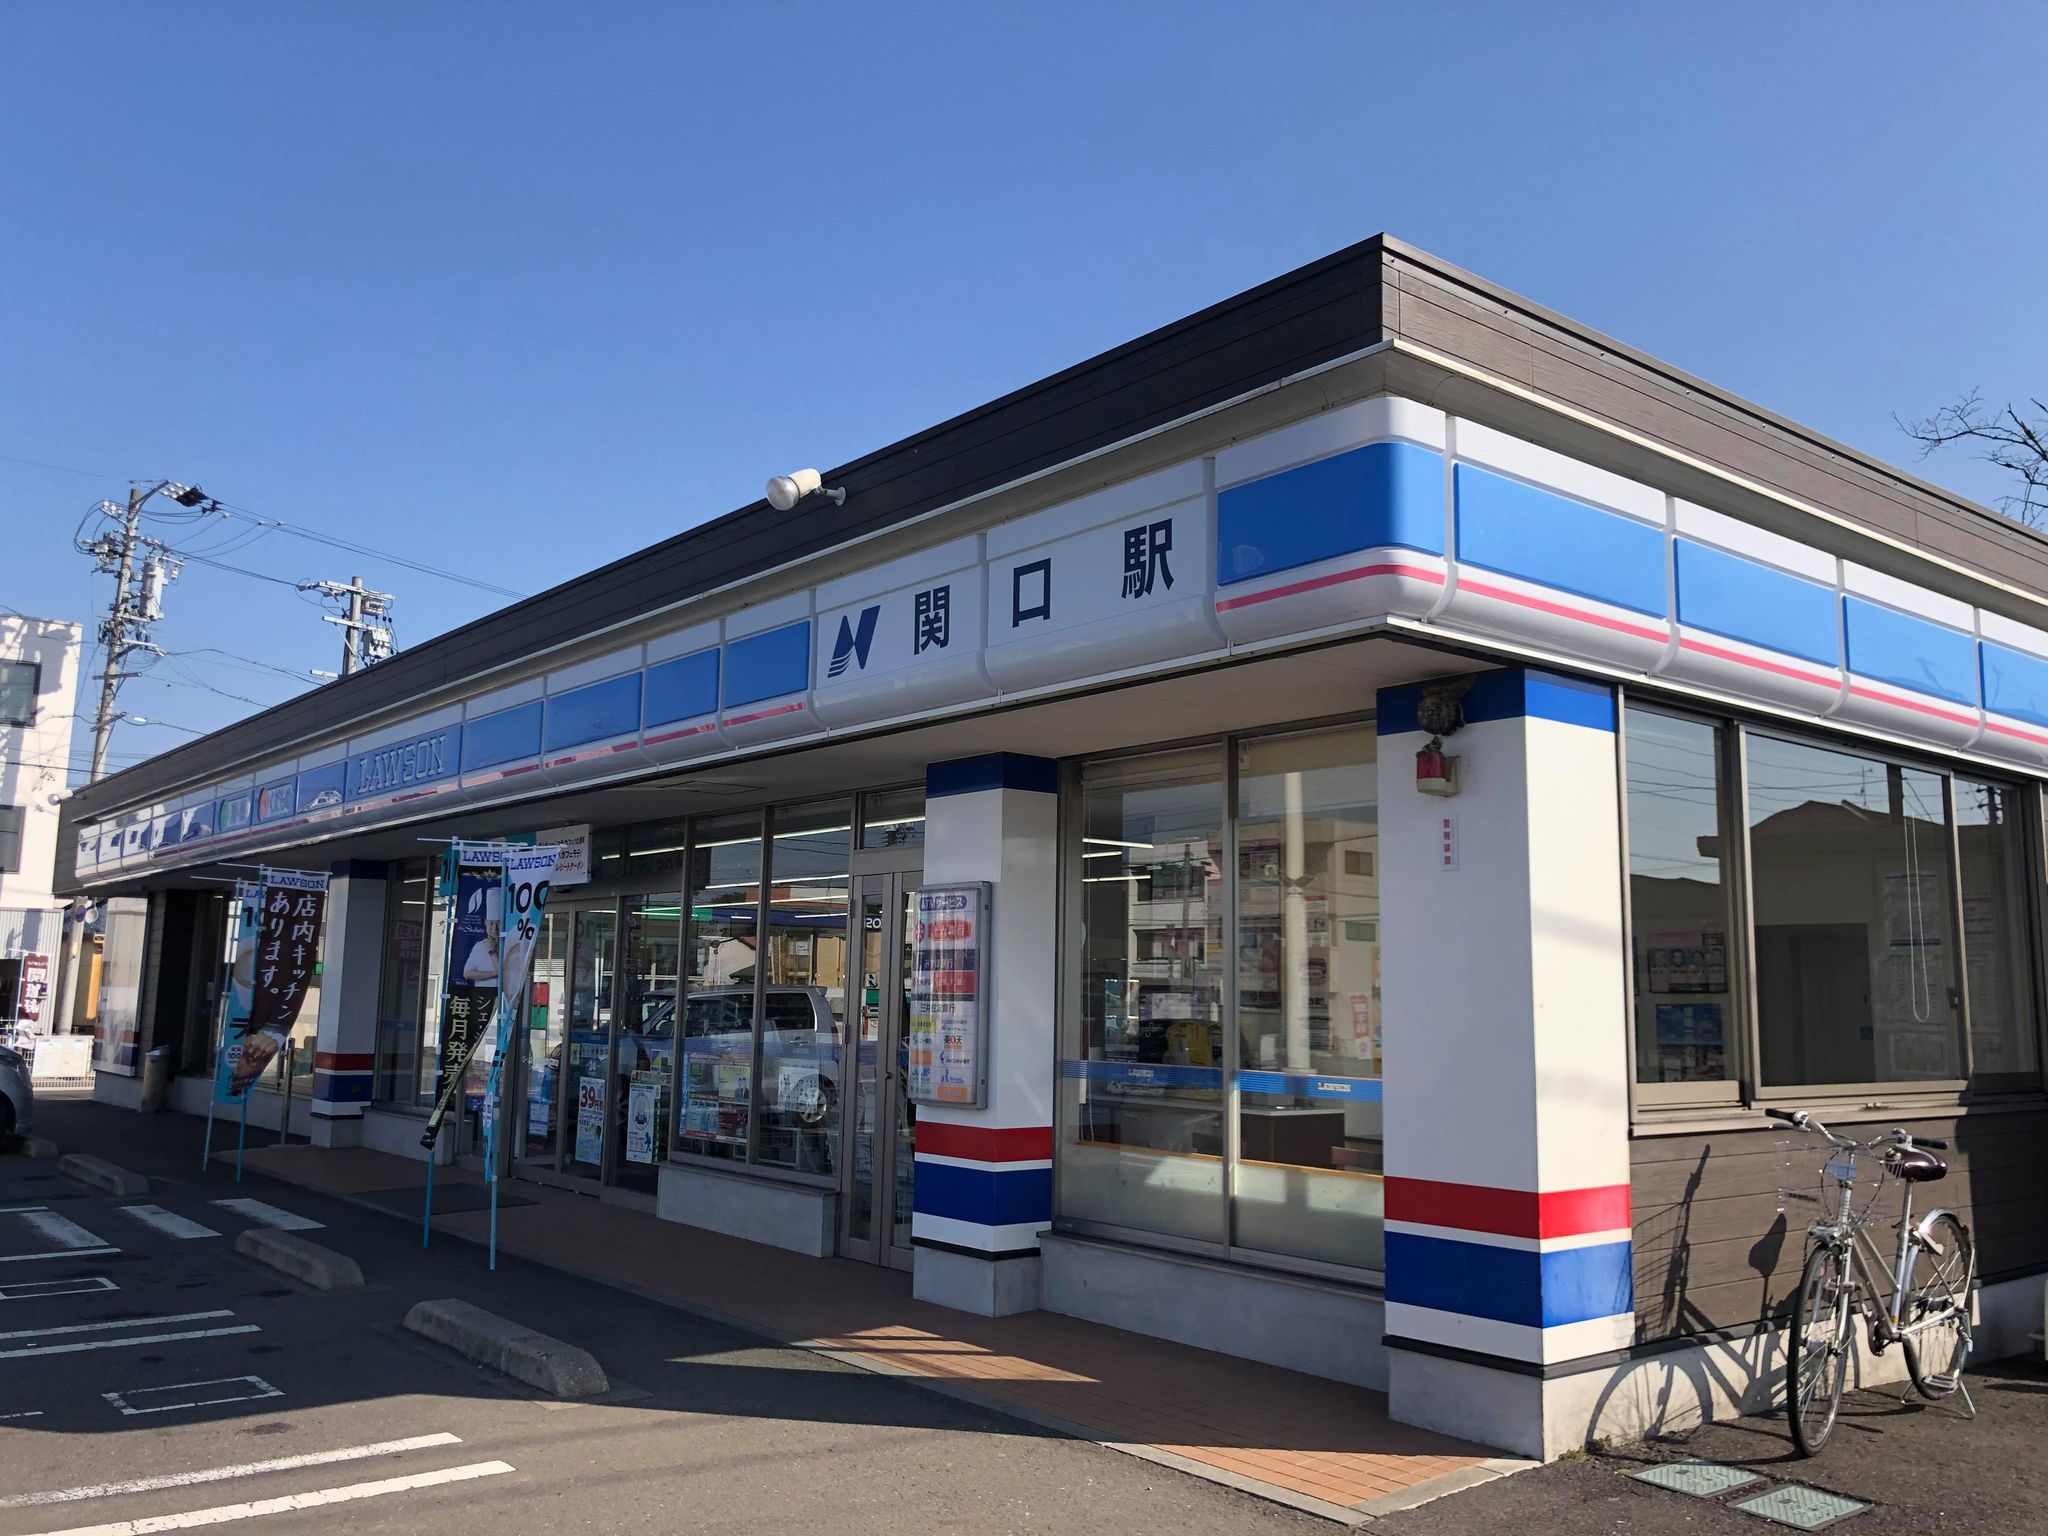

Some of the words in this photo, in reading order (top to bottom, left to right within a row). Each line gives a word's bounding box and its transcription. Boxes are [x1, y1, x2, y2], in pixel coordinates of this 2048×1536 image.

[914, 518, 1175, 655] 関口駅
[358, 735, 447, 794] LAWSON
[270, 875, 325, 889] LAWSON
[510, 855, 557, 870] LAWSON
[261, 891, 290, 994] あります。
[278, 893, 317, 1019] 店内キッチン
